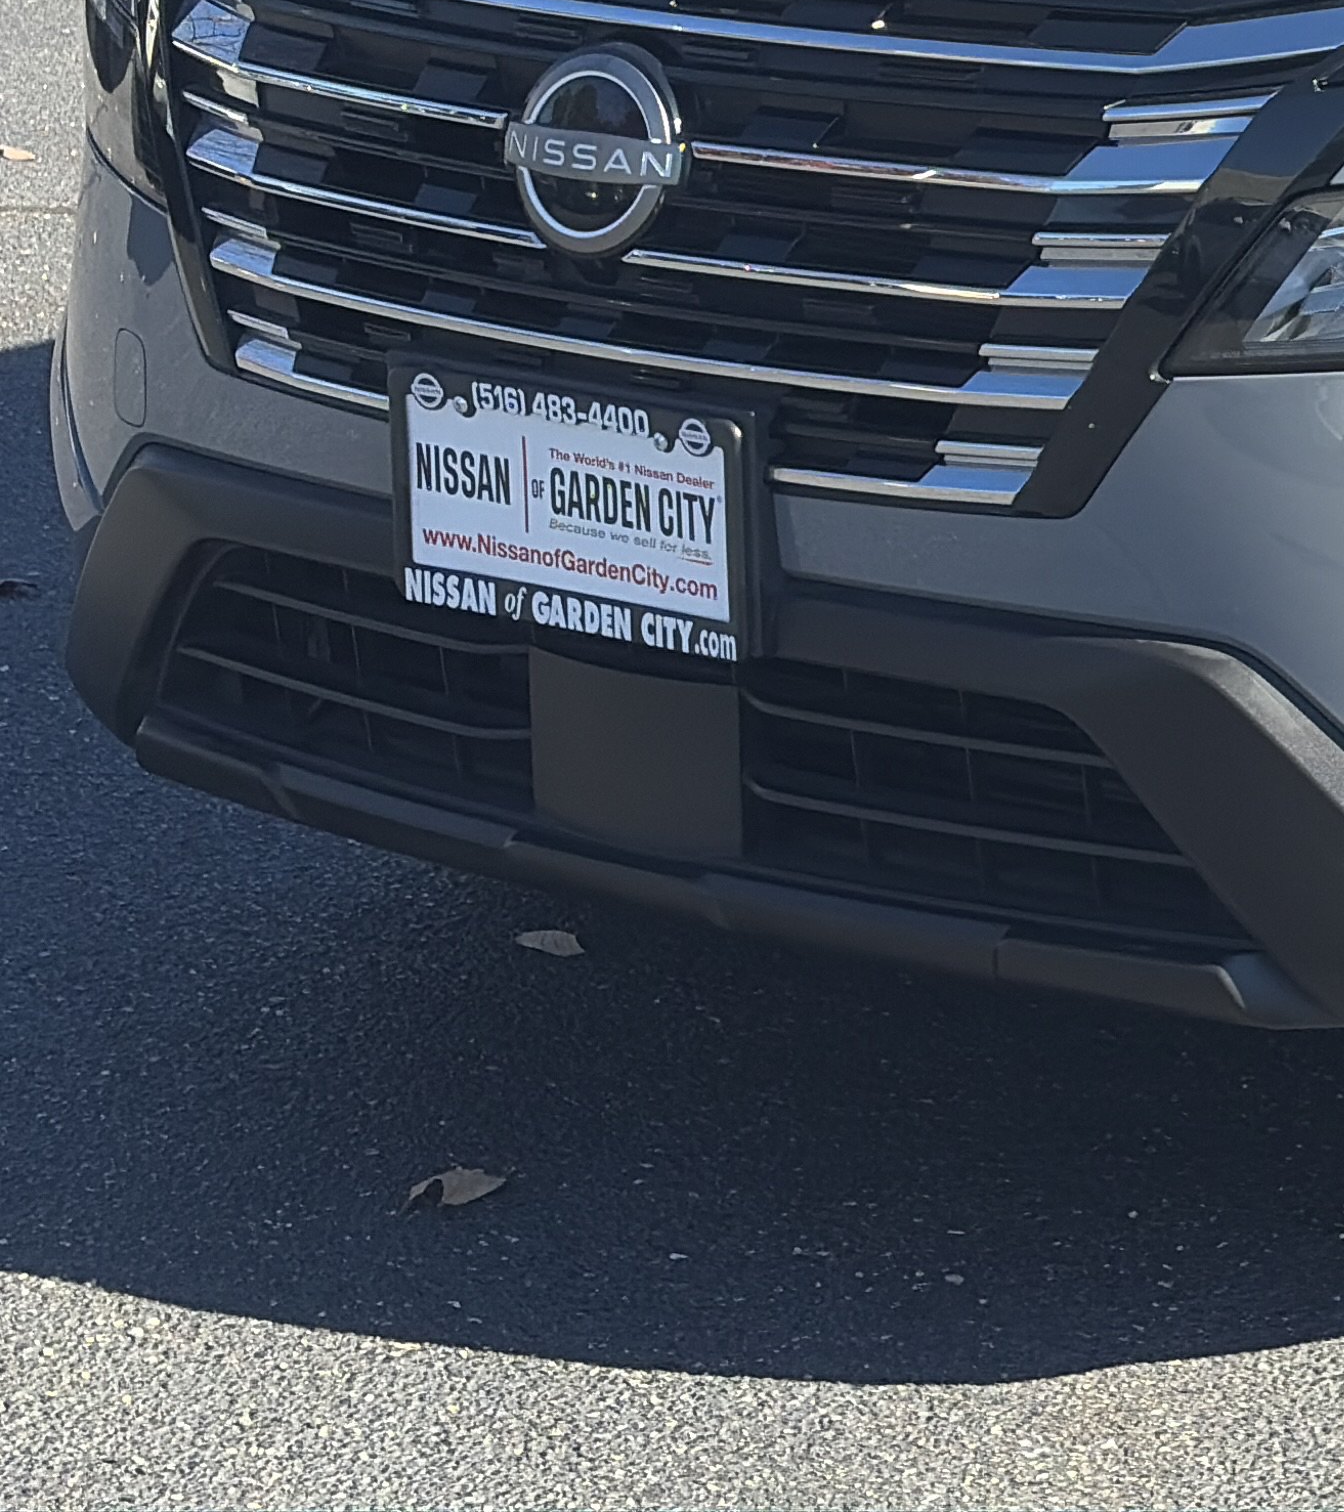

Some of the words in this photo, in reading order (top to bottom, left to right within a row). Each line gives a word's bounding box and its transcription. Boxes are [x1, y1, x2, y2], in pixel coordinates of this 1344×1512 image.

[508, 130, 673, 178] NISSAN
[471, 381, 525, 416] (516)
[532, 392, 650, 437] 483-4400
[415, 441, 512, 506] NISSAN
[531, 477, 545, 500] OF
[549, 448, 570, 462] The
[572, 452, 615, 471] World's
[634, 464, 673, 482] Nissan
[676, 471, 715, 490] Dealer
[549, 467, 651, 533] GARDEN
[658, 487, 715, 545] CITY
[549, 518, 606, 539] Because
[609, 531, 630, 544] we
[633, 535, 657, 550] sell
[660, 539, 677, 553] for
[421, 527, 718, 601] www.NissanofGardenCity.com
[404, 566, 497, 616] NISSAN
[504, 586, 528, 621] of
[531, 590, 633, 642] GARDEN
